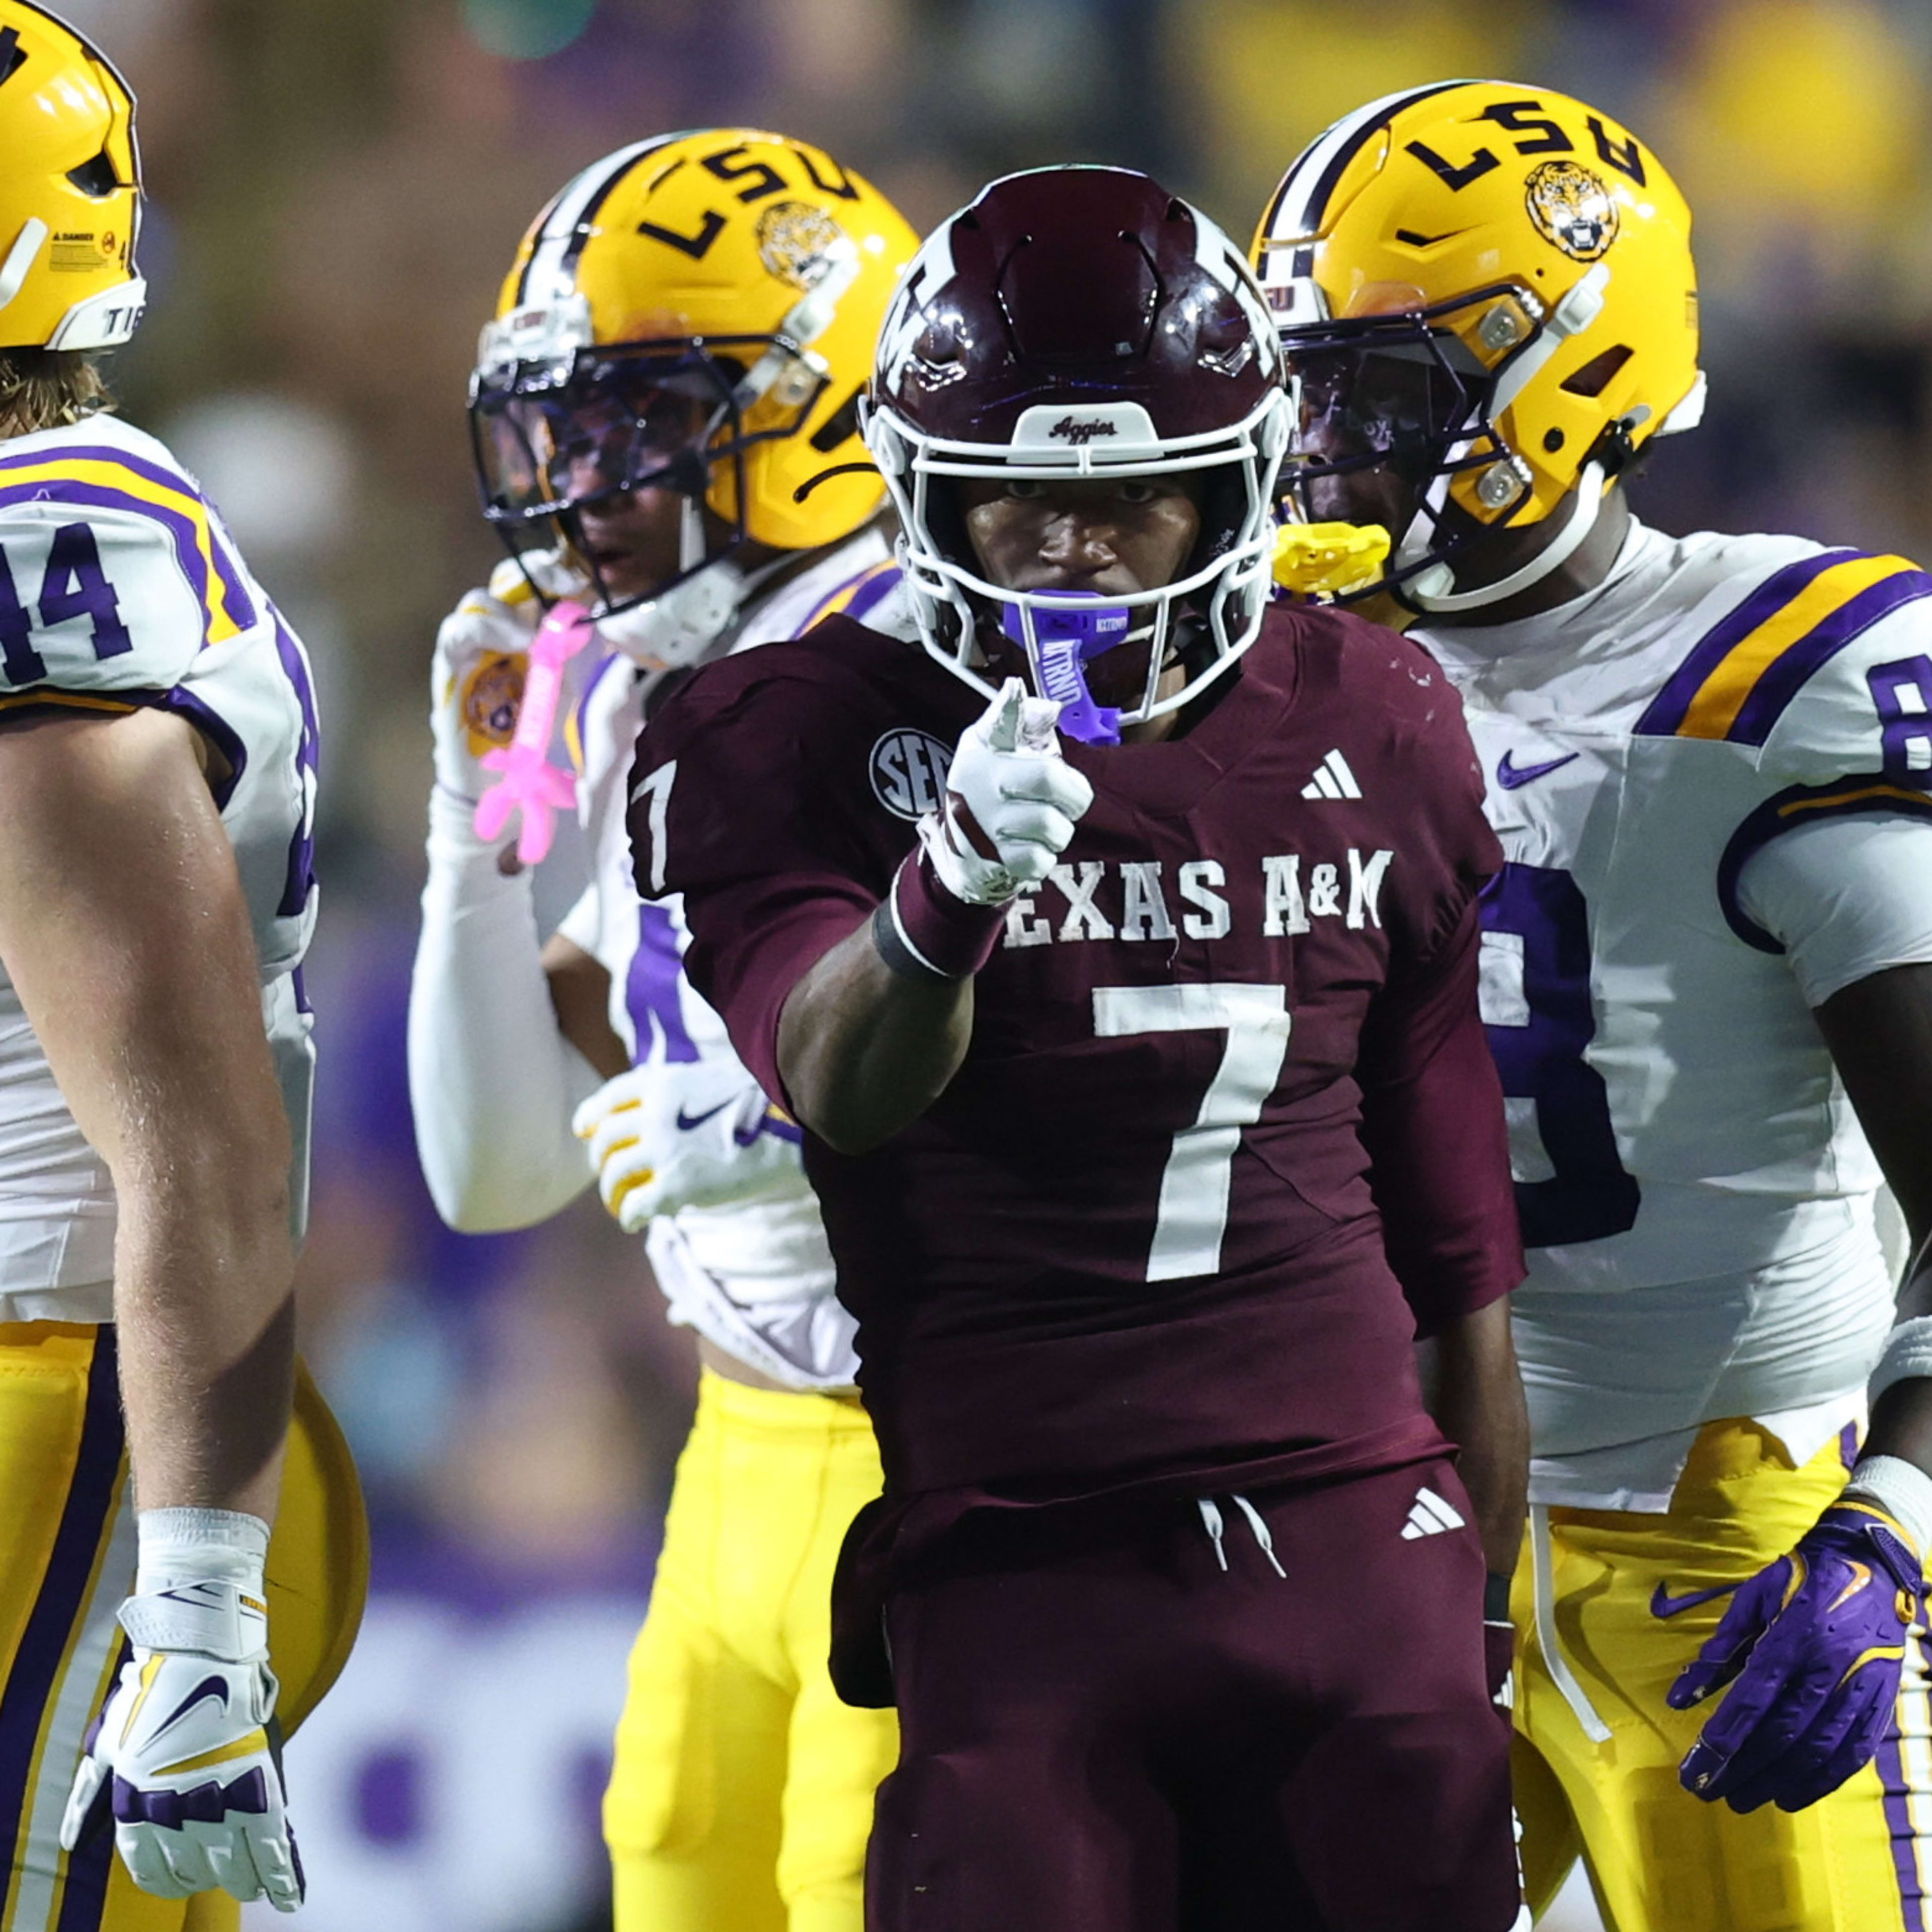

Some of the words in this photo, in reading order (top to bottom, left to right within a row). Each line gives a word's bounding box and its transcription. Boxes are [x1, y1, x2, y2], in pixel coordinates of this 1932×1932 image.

[1404, 101, 1647, 192] LSU
[637, 145, 860, 259] LSU
[1264, 285, 1295, 311] SU
[1049, 415, 1118, 445] Aggies
[1003, 860, 1230, 947] EXAS
[1092, 983, 1291, 1282] 7
